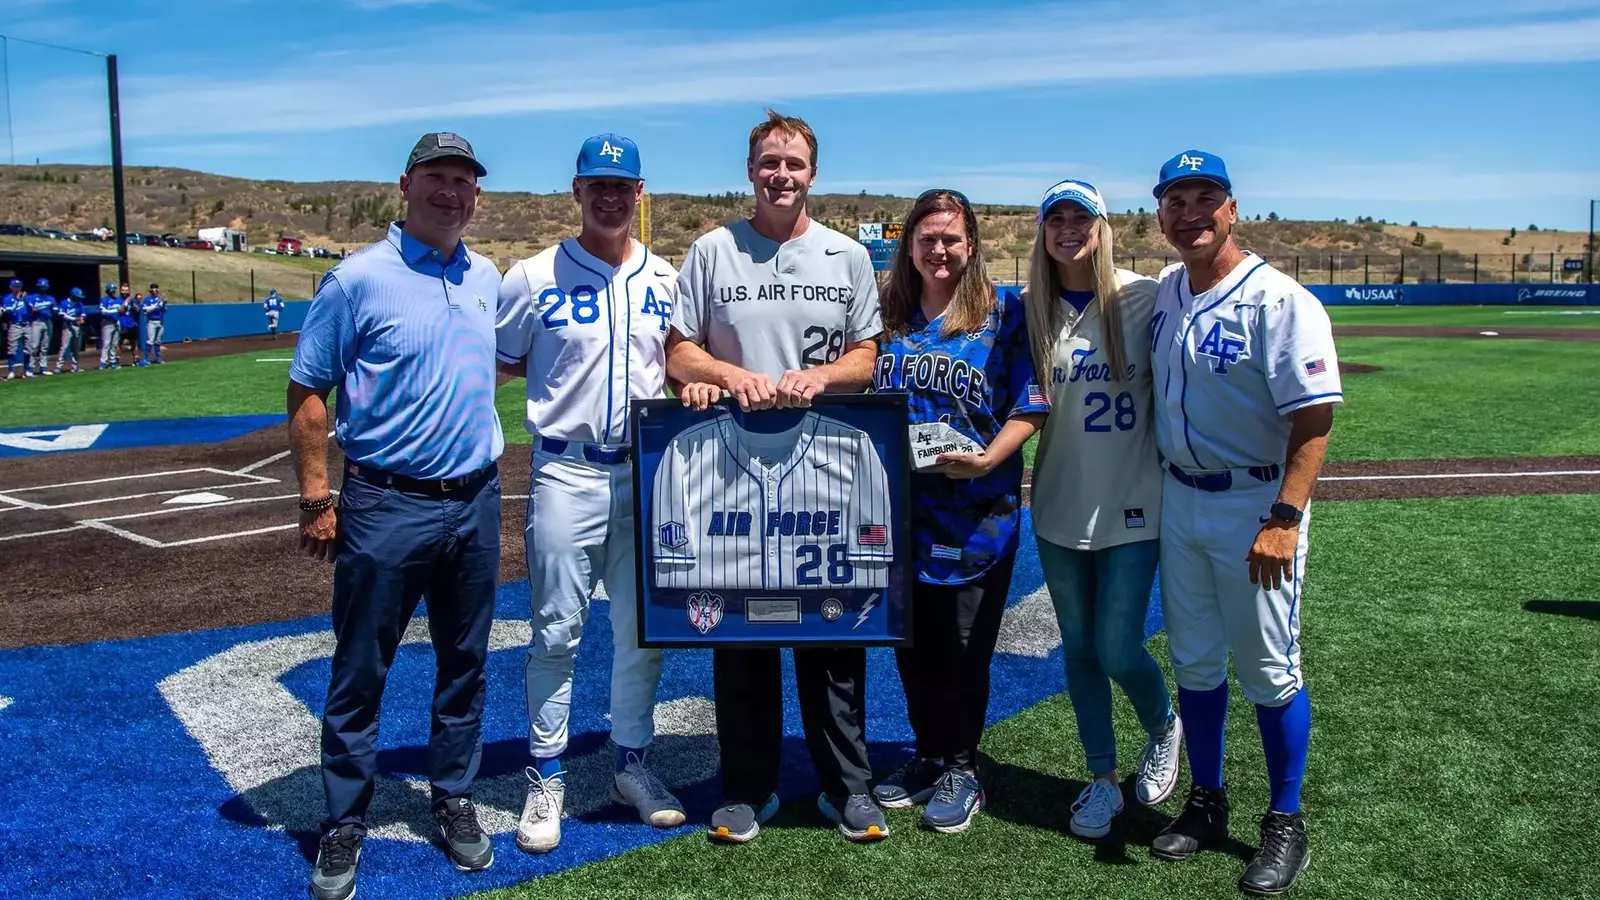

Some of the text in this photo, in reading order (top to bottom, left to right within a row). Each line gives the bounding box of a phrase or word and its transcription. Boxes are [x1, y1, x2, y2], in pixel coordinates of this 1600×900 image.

[600, 140, 624, 164] AF
[1177, 153, 1204, 171] AF
[538, 284, 600, 329] 28
[720, 284, 848, 304] U.S. AIR FORCE
[1361, 288, 1395, 300] USAA
[1534, 289, 1587, 297] BOEING
[641, 286, 672, 332] AF
[802, 325, 844, 365] 28
[1197, 320, 1246, 374] AF
[1069, 347, 1136, 382] Fore
[900, 353, 984, 409] FORCE
[1084, 391, 1136, 432] 28
[916, 431, 932, 445] AF
[917, 442, 958, 459] FAIRBURN
[707, 510, 840, 536] AIR FORCE
[796, 544, 854, 585] 28
